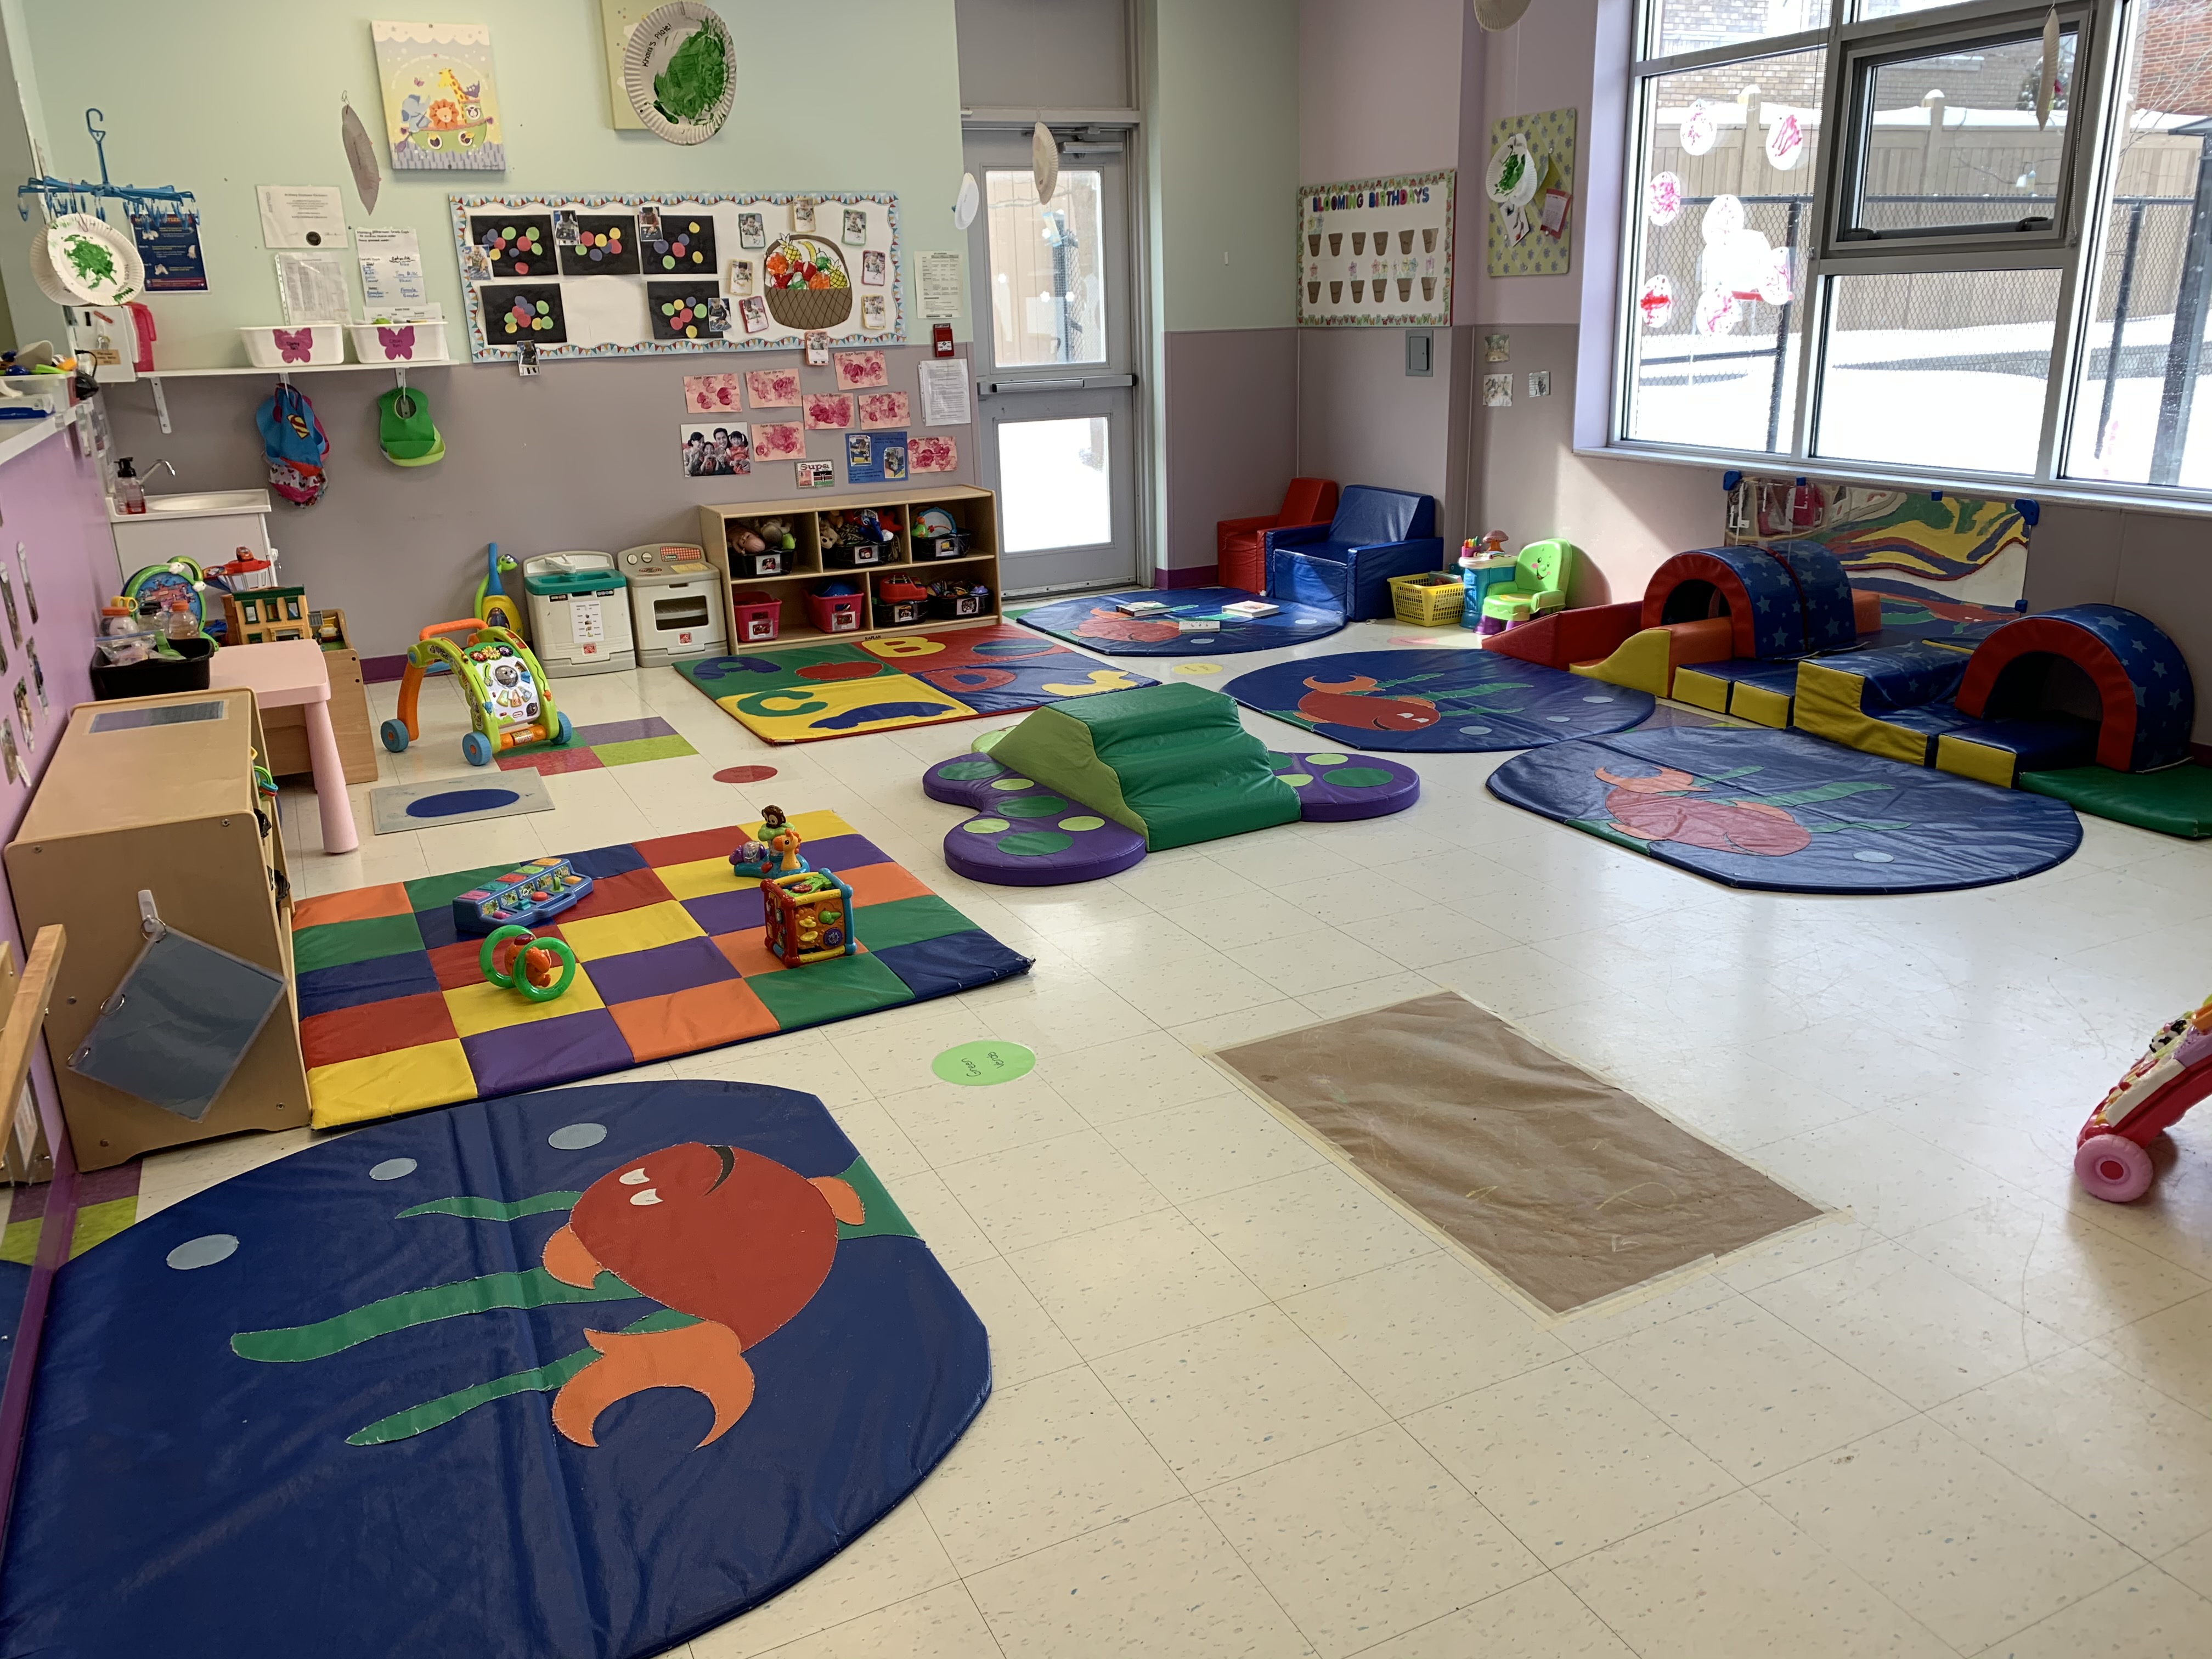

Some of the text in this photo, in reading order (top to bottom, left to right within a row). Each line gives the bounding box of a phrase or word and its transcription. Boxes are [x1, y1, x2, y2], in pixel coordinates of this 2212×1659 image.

[654, 23, 673, 40] Plate!
[1313, 187, 1430, 212] BLOOMING BIRTHDAYS
[861, 636, 946, 657] B
[736, 689, 828, 716] C
[961, 1058, 981, 1077] Green
